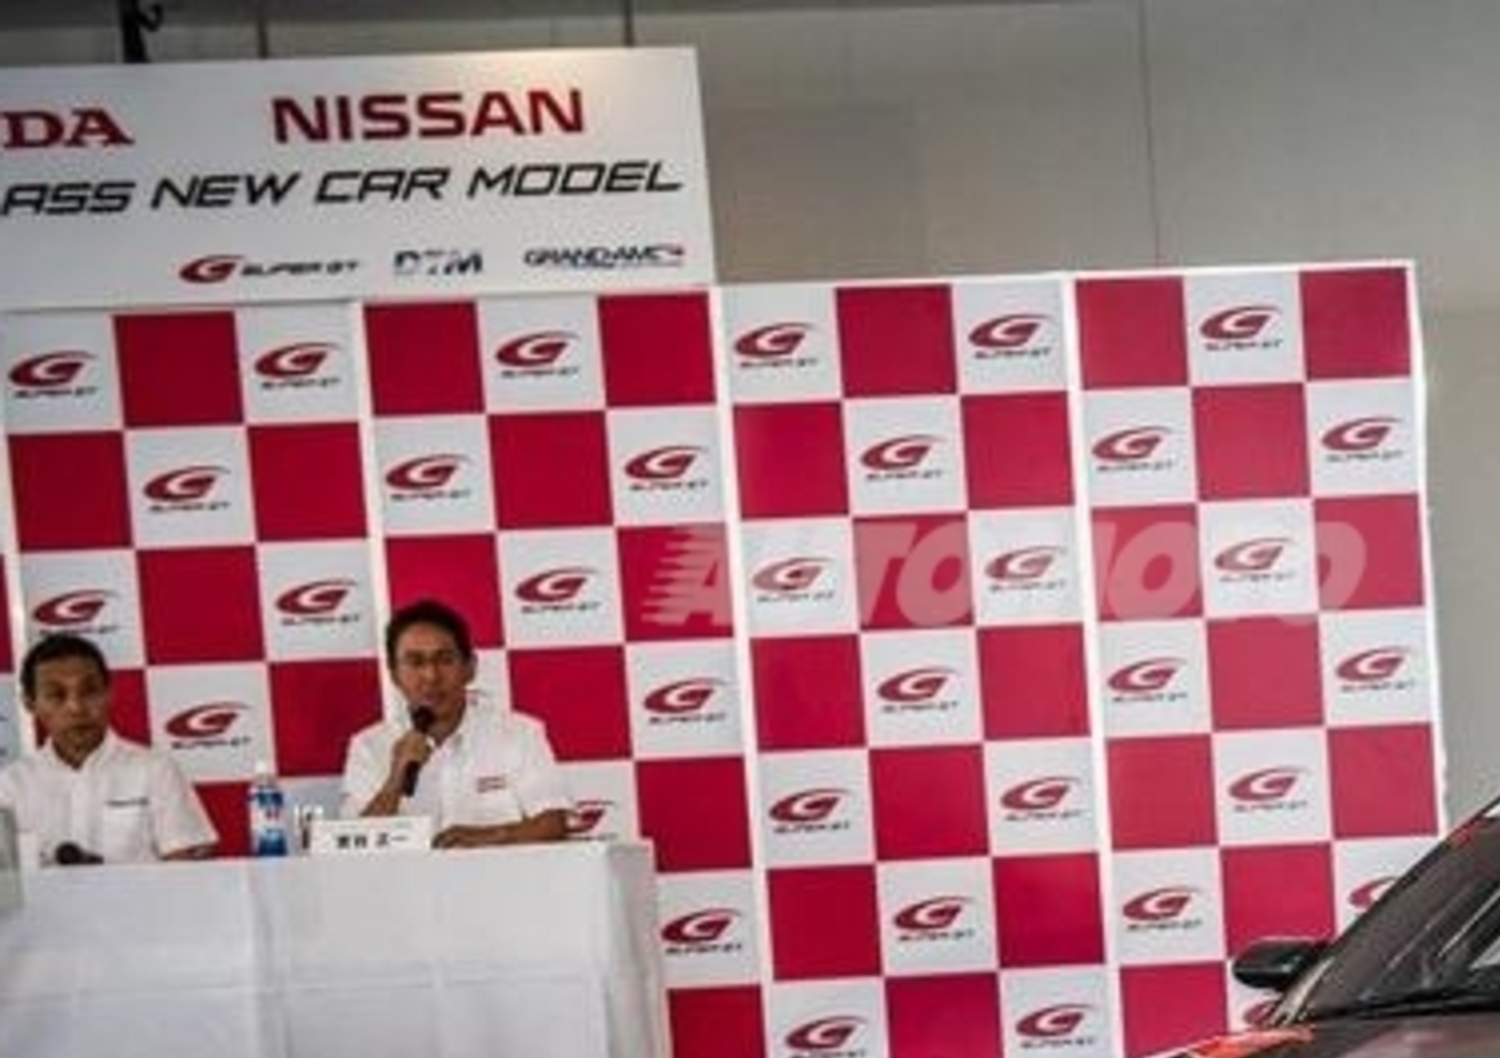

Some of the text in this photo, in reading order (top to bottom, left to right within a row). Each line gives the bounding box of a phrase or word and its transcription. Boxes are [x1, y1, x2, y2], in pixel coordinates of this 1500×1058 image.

[271, 88, 584, 144] NISSAN
[150, 170, 302, 210] NEW
[314, 165, 451, 205] CAR
[466, 160, 684, 199] MODEL
[394, 248, 484, 276] DTM
